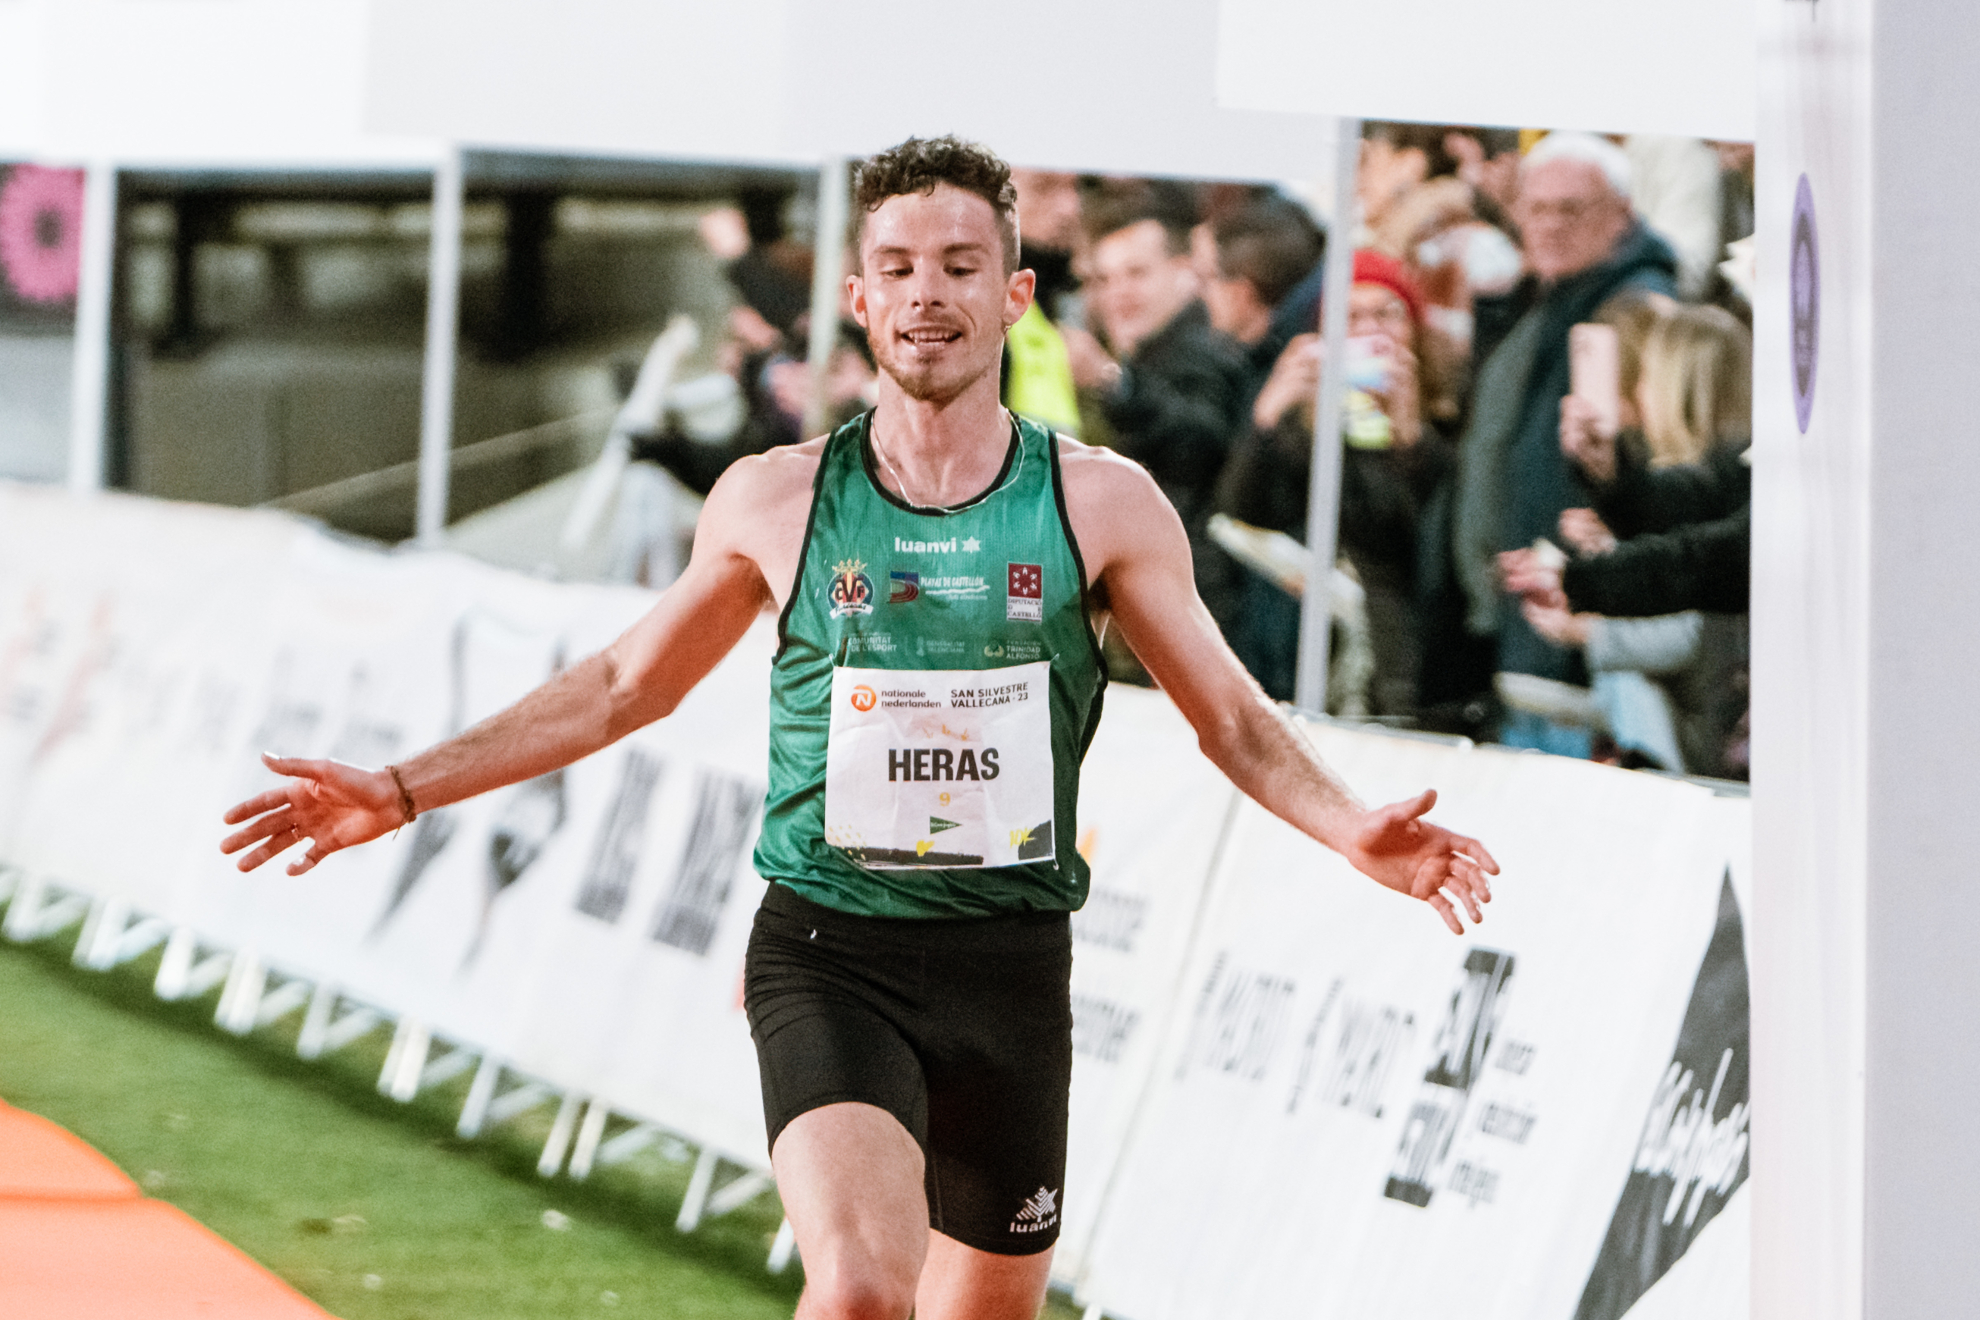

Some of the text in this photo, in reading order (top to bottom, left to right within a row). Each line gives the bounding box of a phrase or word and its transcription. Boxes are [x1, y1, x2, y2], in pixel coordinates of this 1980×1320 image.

[894, 537, 956, 553] luanvi
[920, 577, 942, 587] PLAYAS
[881, 689, 926, 698] nationale
[951, 682, 1028, 698] SAN SILVESTRE
[881, 699, 941, 708] nederlanden
[951, 692, 1028, 708] VALLECANA 23
[888, 748, 1000, 782] HERAS
[939, 792, 951, 807] 9
[1009, 1214, 1057, 1233] luanvi
